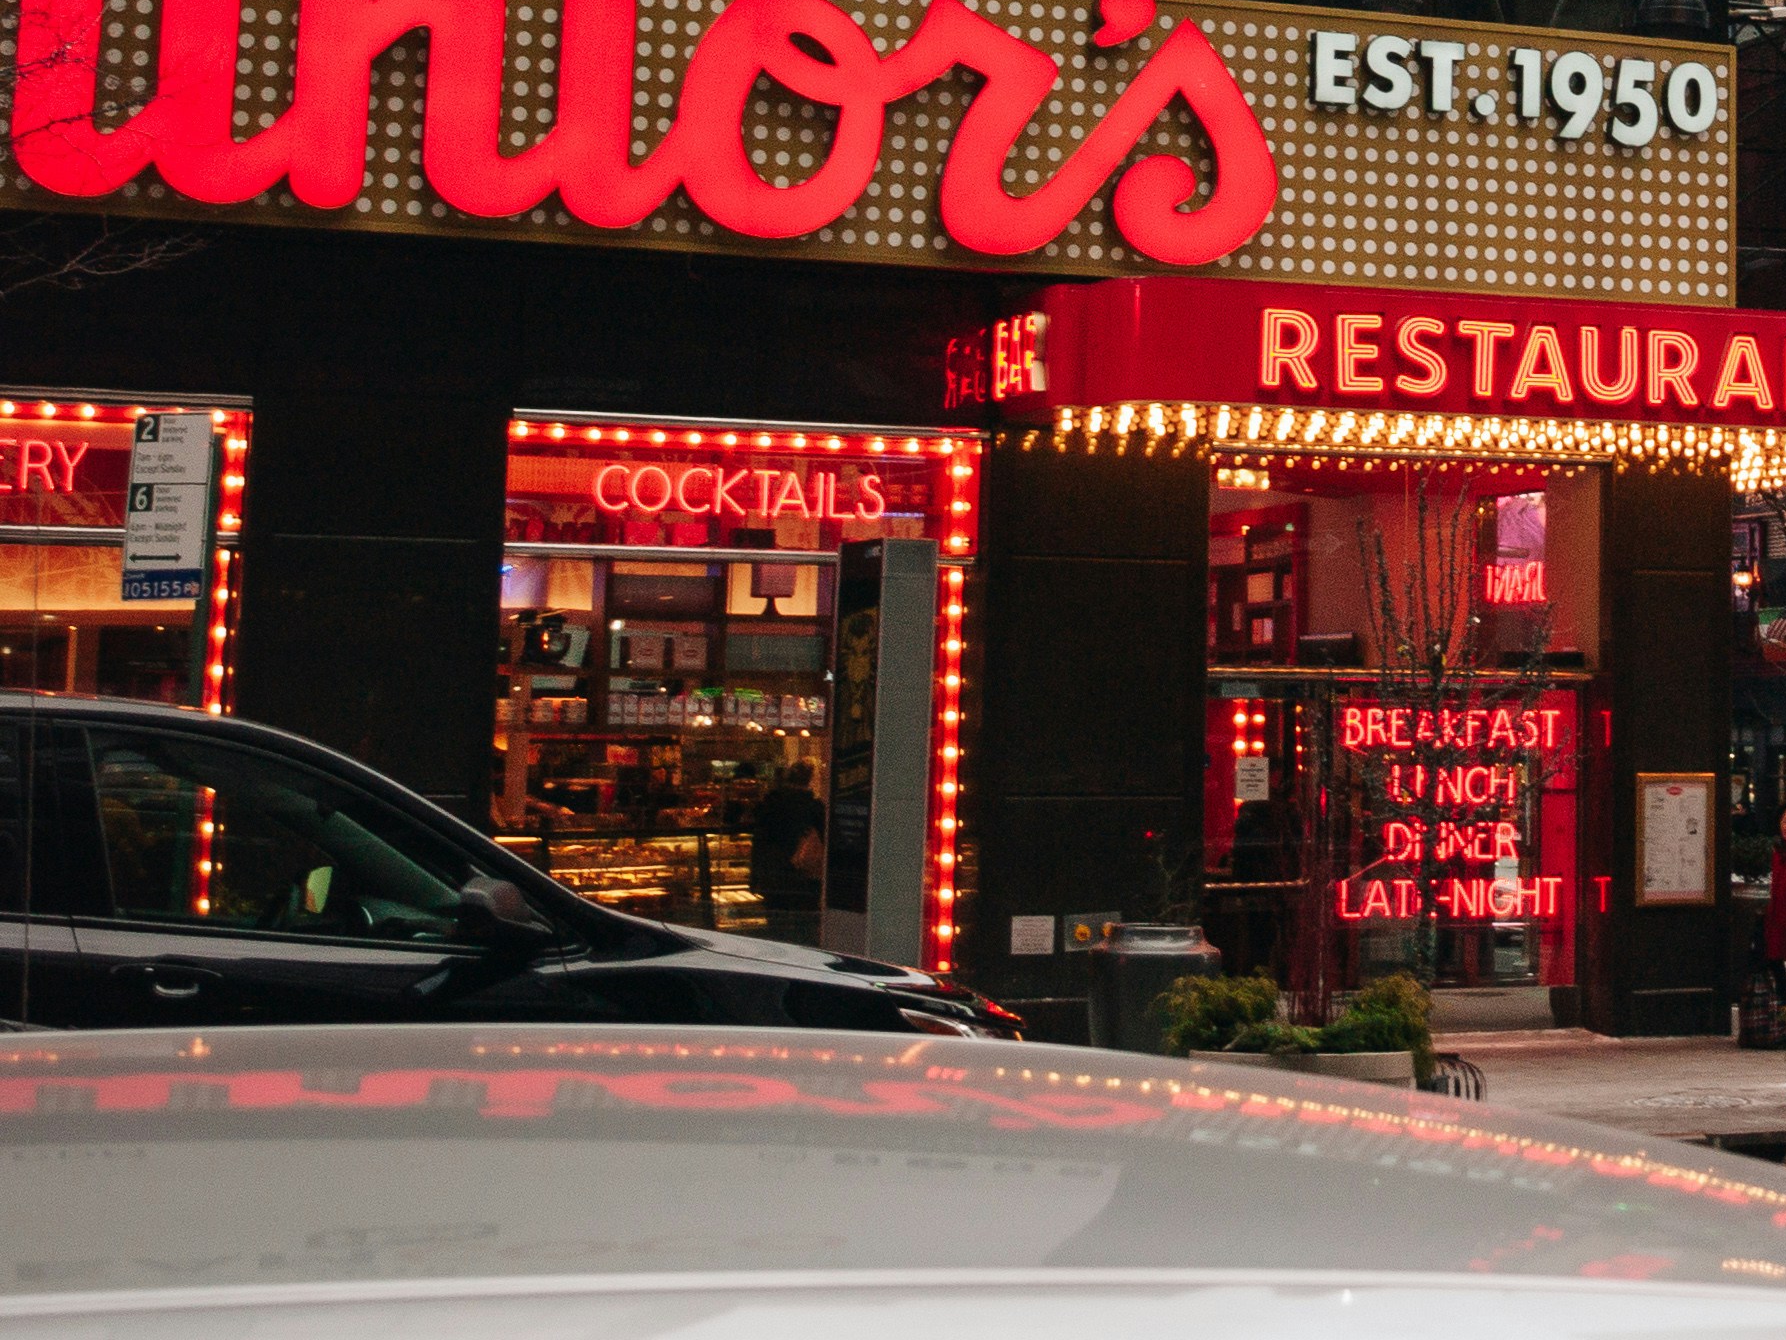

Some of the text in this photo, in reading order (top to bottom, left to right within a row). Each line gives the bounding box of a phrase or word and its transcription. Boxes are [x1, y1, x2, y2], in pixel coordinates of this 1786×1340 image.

[1312, 30, 1719, 147] EST. 1950
[141, 416, 155, 440] 2
[135, 486, 148, 511] 6
[595, 463, 886, 520] COCKTAILS
[1344, 707, 1561, 750] BREAKFAST
